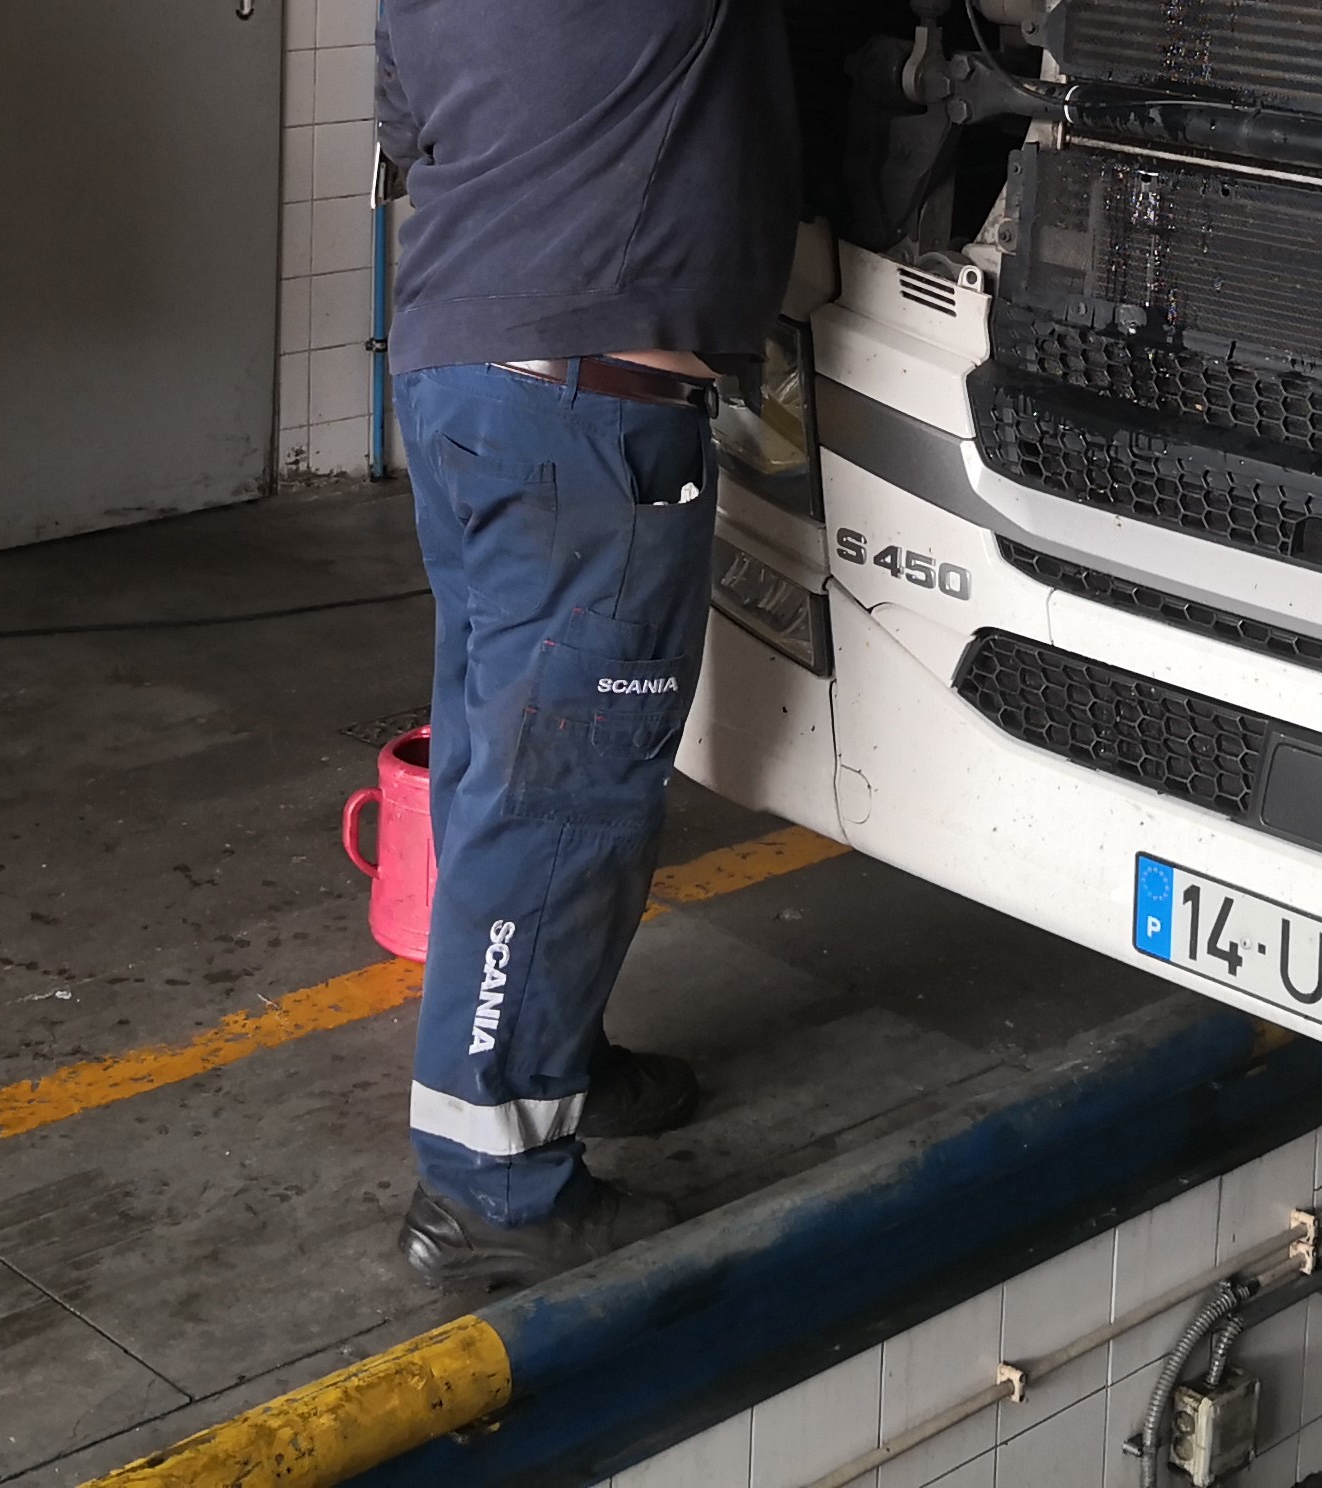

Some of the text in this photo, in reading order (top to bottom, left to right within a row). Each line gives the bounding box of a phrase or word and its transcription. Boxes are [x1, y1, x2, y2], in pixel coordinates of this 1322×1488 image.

[836, 527, 972, 601] S 450
[597, 677, 678, 694] SCANIA
[1146, 916, 1162, 938] P
[469, 919, 516, 1055] SCANIA
